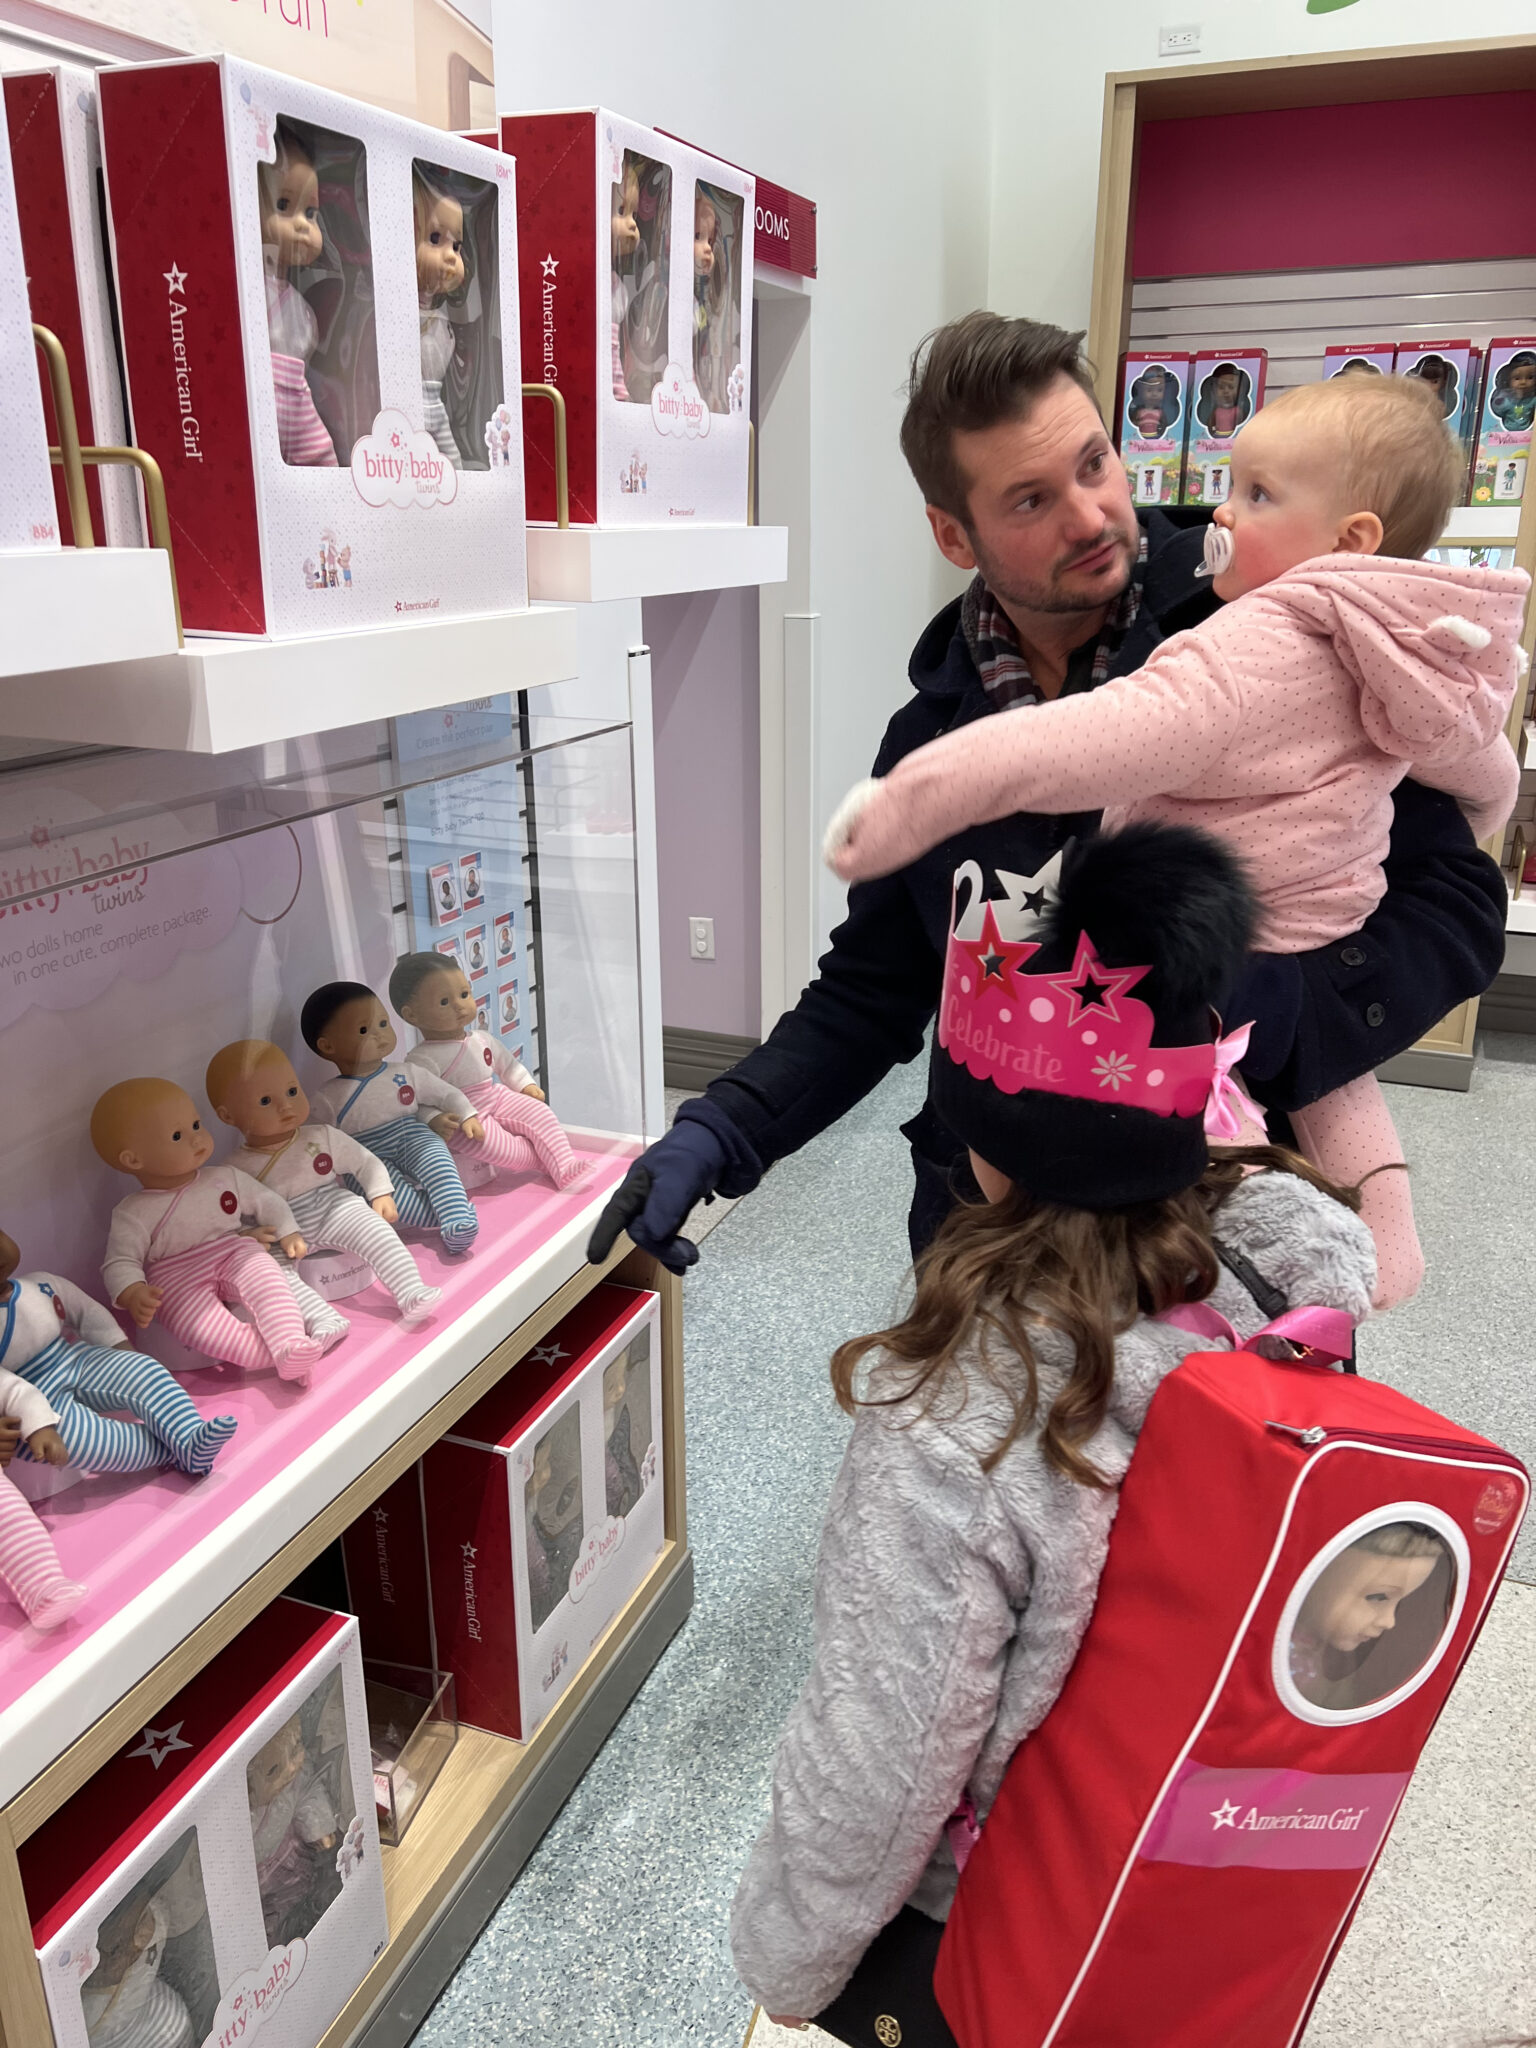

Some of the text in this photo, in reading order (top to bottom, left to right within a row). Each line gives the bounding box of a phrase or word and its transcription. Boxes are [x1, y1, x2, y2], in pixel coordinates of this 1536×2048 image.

[753, 206, 790, 241] OOMS
[543, 364, 558, 386] Gi
[658, 391, 704, 422] bitty baby
[363, 449, 445, 485] bitty baby
[0, 863, 61, 919] itty
[91, 884, 146, 915] twins
[0, 922, 104, 969] wo dolls home
[13, 970, 28, 986] in
[30, 958, 60, 980] one
[101, 922, 160, 956] complete
[947, 993, 1067, 1083] Celebrate
[574, 1554, 597, 1587] bitty
[218, 1948, 293, 2048] itty baby
